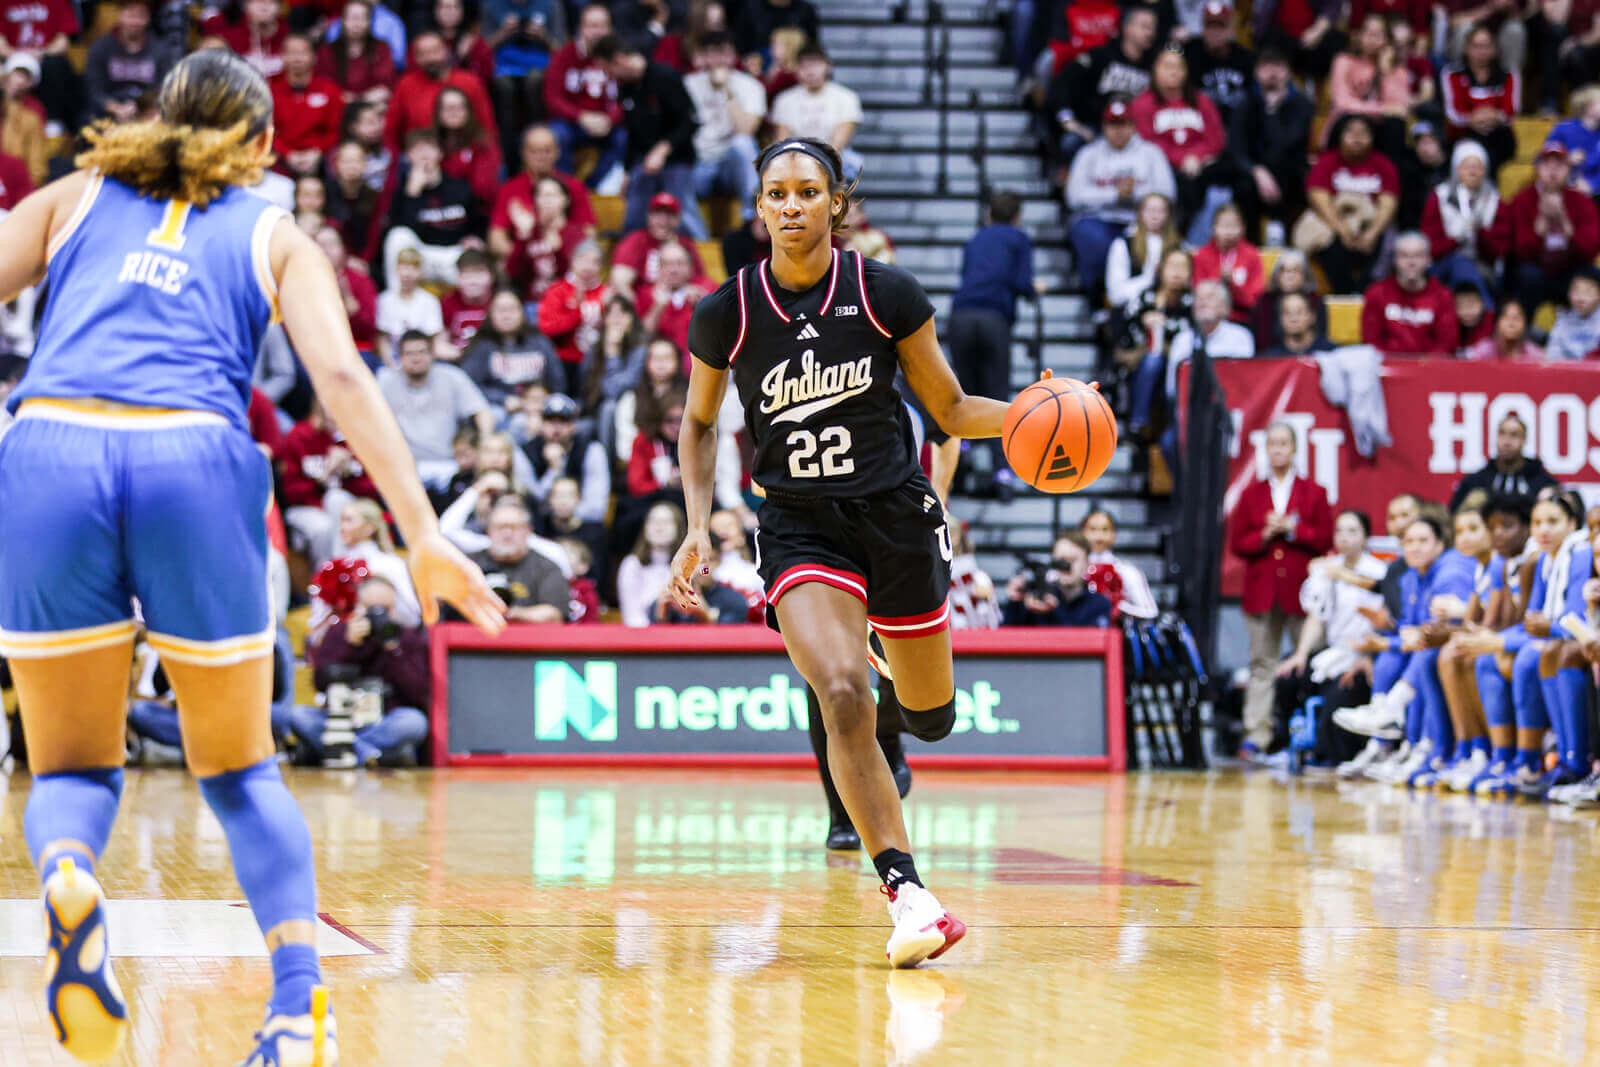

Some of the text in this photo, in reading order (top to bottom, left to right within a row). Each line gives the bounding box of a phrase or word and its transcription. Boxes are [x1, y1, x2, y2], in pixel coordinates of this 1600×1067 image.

[118, 251, 189, 295] RICE
[760, 349, 872, 422] Indiana
[786, 426, 855, 478] 22
[1428, 391, 1600, 475] HOO
